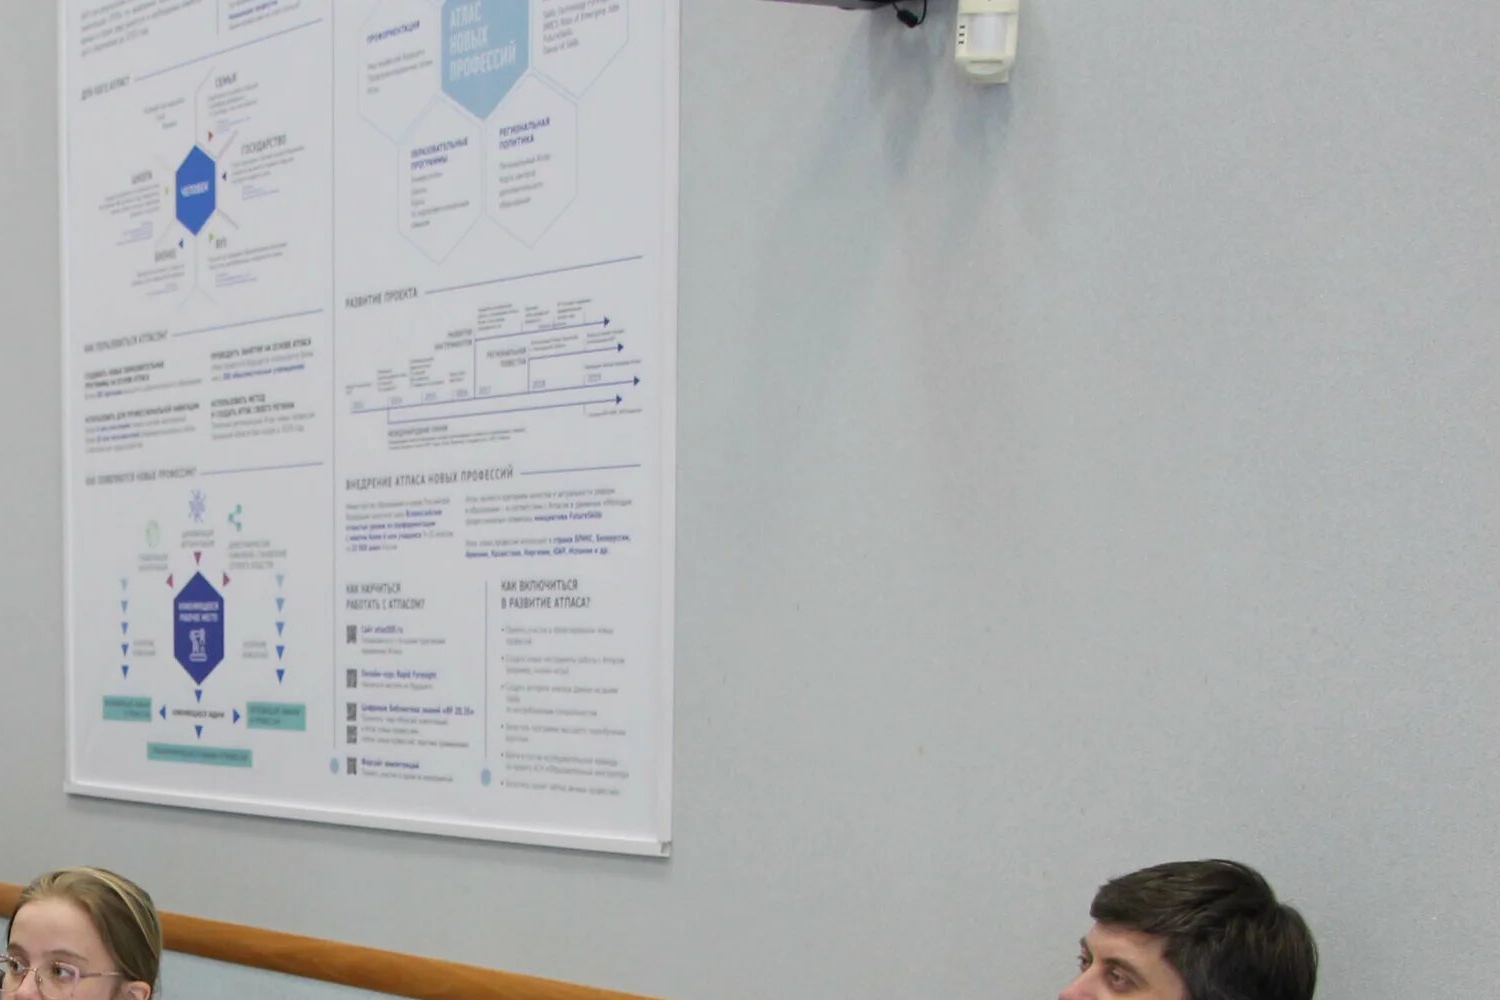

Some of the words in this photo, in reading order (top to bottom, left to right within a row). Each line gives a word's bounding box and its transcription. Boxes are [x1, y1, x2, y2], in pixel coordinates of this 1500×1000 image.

[501, 580, 517, 592] КАК
[519, 578, 578, 591] ВКЛЮЧИТЬСЯ
[509, 597, 551, 609] РАЗВИТИЕ
[553, 596, 591, 608] АТЛАСА?
